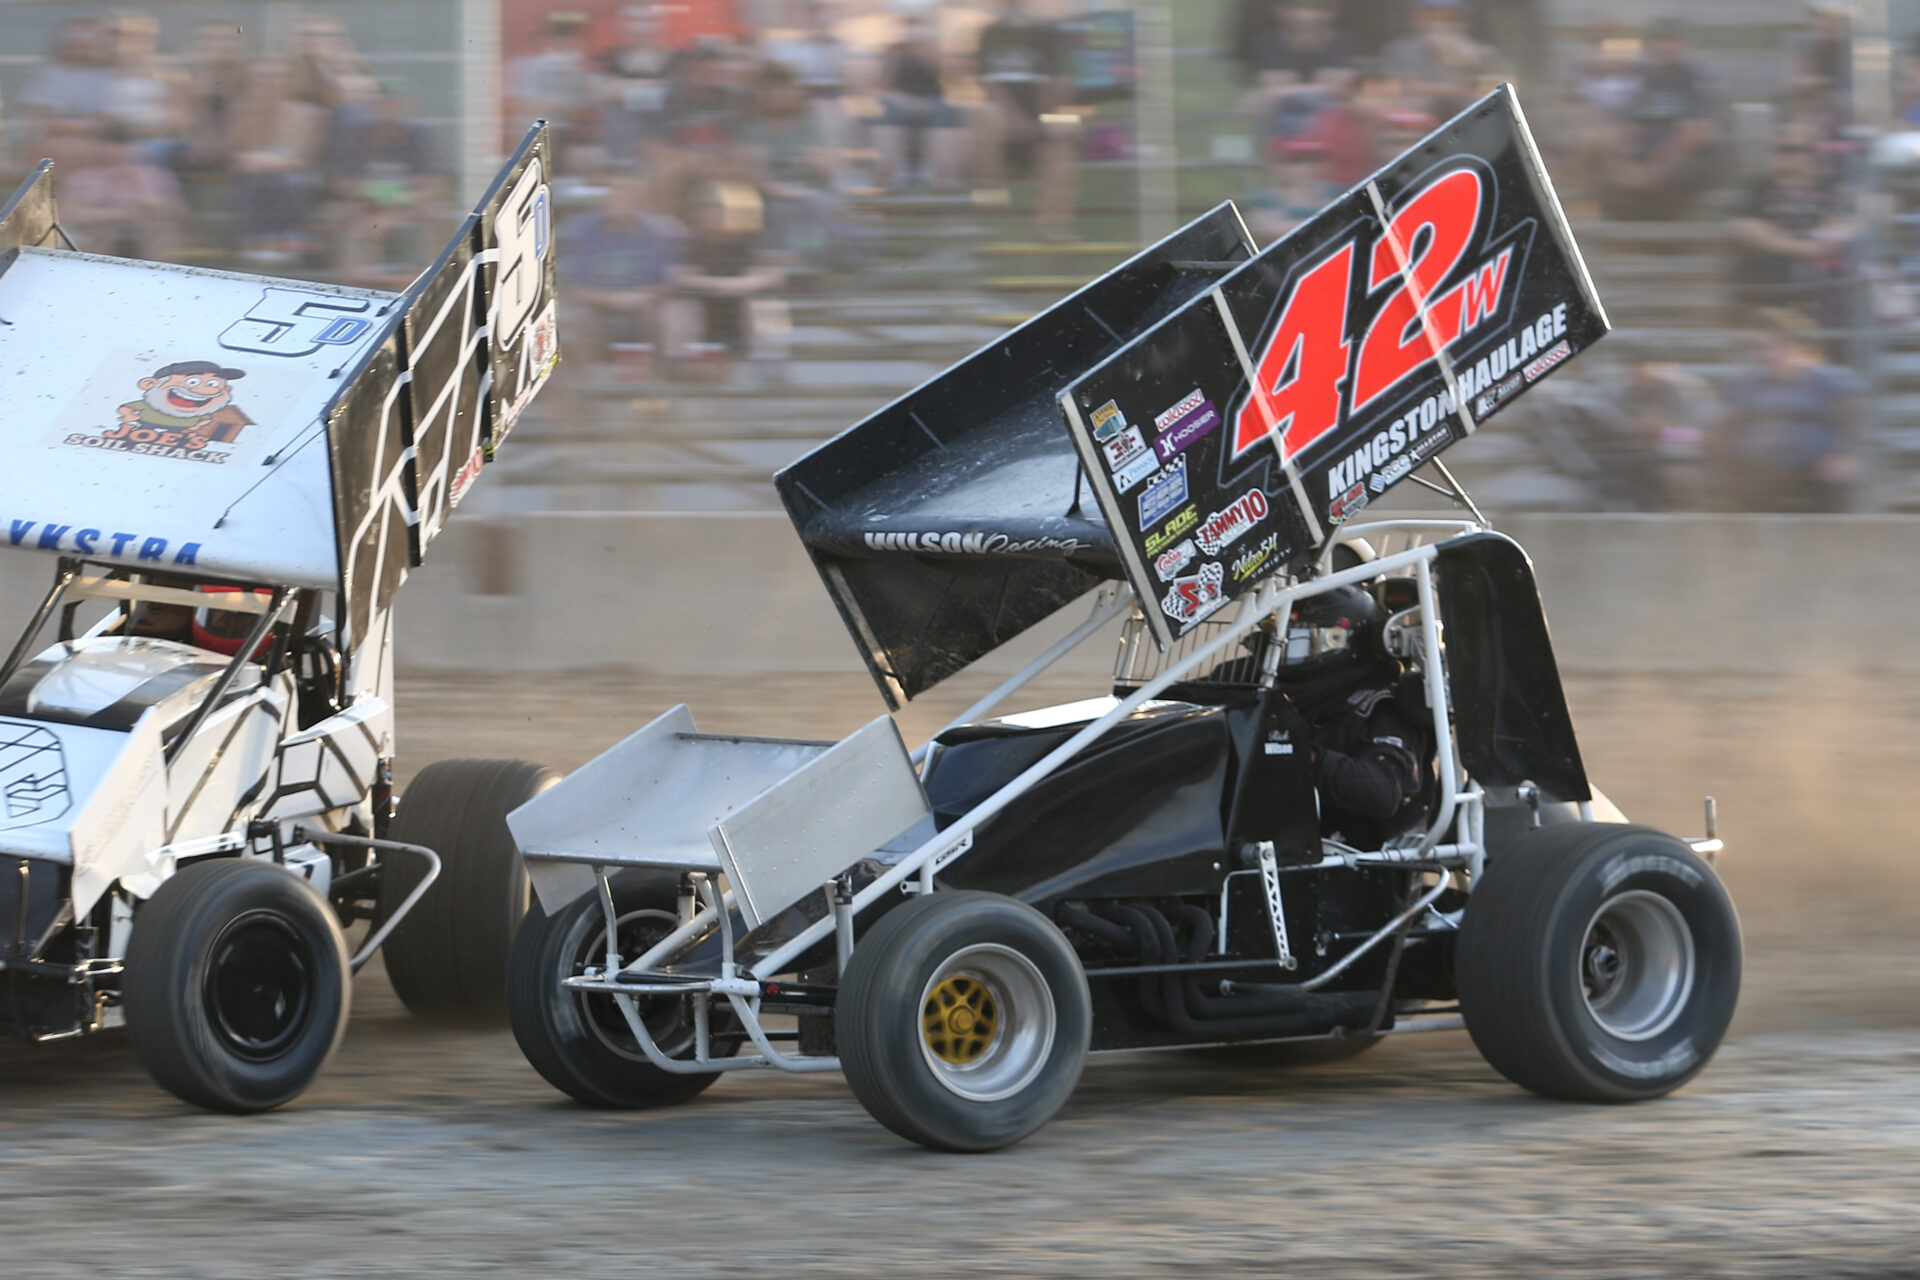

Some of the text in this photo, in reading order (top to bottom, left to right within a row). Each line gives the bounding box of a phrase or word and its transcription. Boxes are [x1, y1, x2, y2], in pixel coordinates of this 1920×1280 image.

[1328, 302, 1567, 500] KINGSTON HAULAGE
[103, 423, 209, 450] JOE'S
[1173, 410, 1215, 442] HOOSIER
[64, 432, 232, 465] SOIL SHACK
[1145, 503, 1197, 549] SLADE
[864, 531, 1092, 556] WILSON Racing
